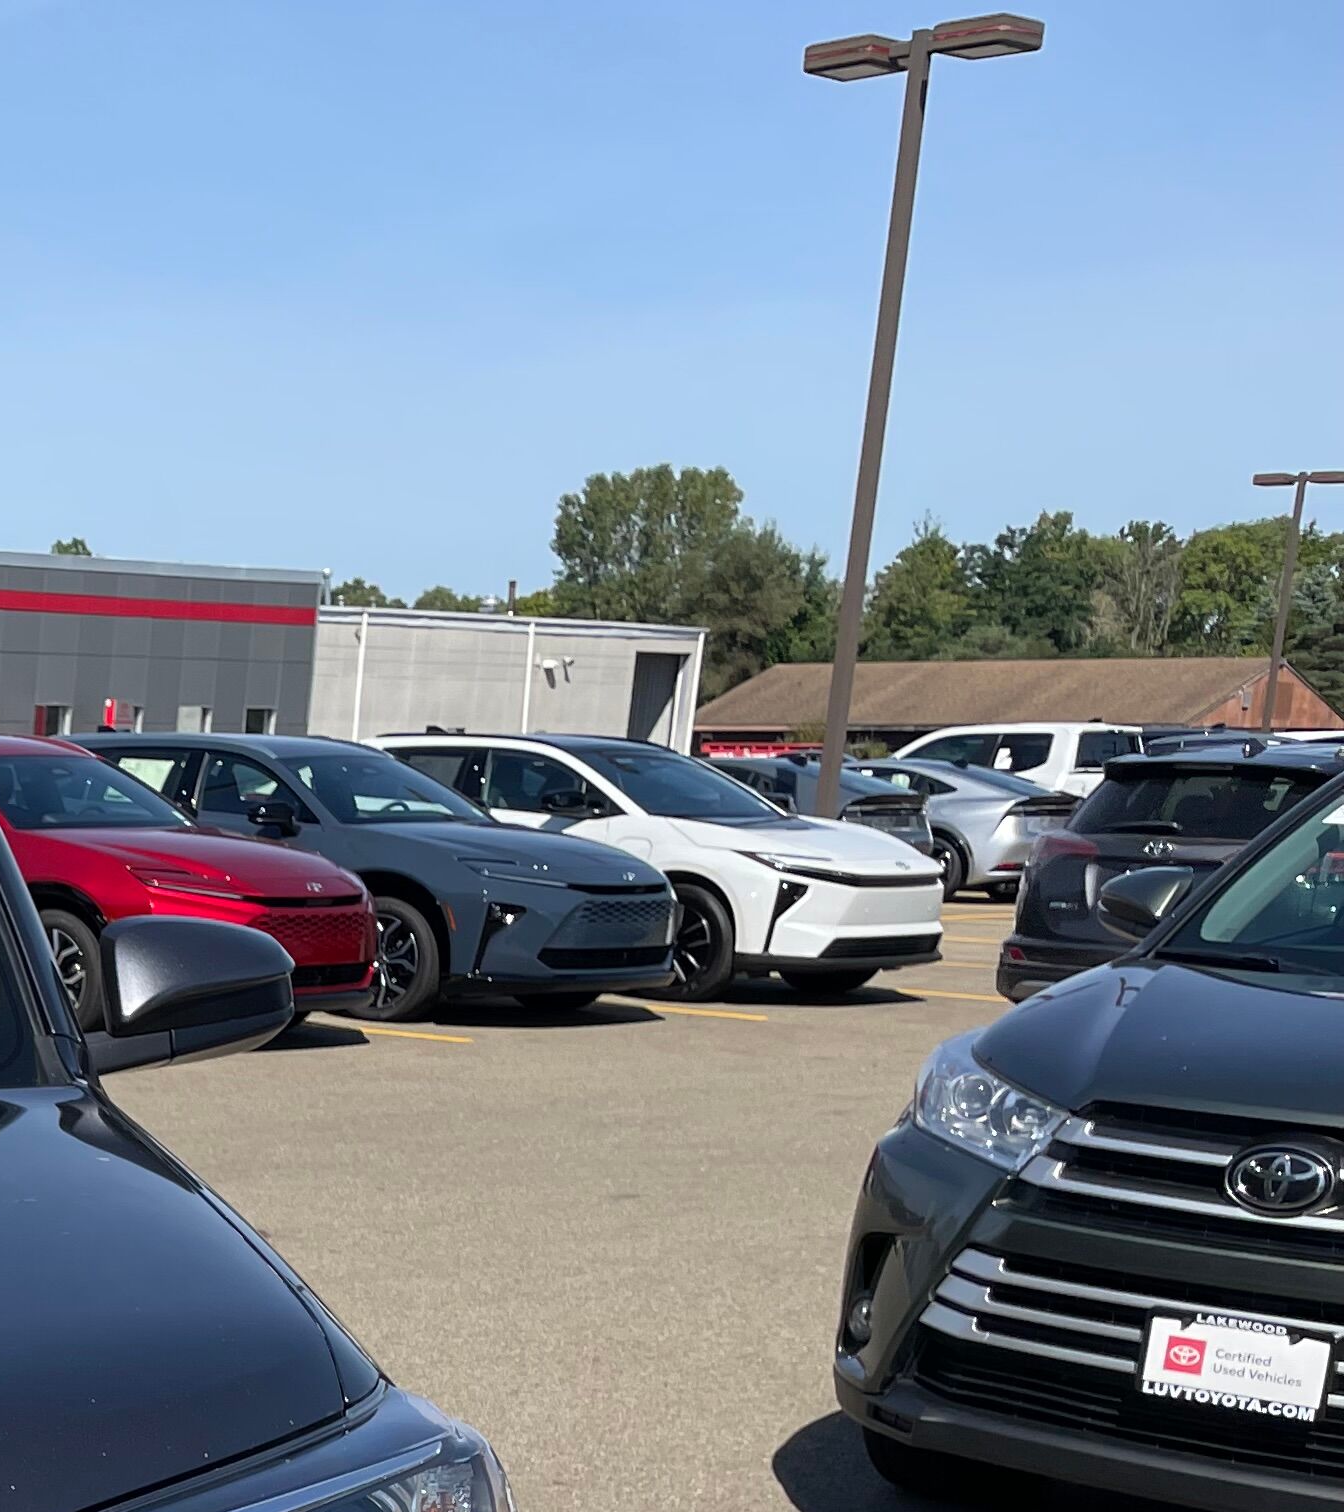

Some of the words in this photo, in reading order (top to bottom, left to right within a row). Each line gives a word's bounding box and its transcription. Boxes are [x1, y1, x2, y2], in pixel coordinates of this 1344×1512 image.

[1196, 1313, 1288, 1336] LAKEWOOD
[1215, 1348, 1272, 1367] Certified
[1213, 1363, 1245, 1378] Used
[1249, 1370, 1302, 1387] Vehicles
[1142, 1380, 1315, 1422] LUVTOYOTA.COM
